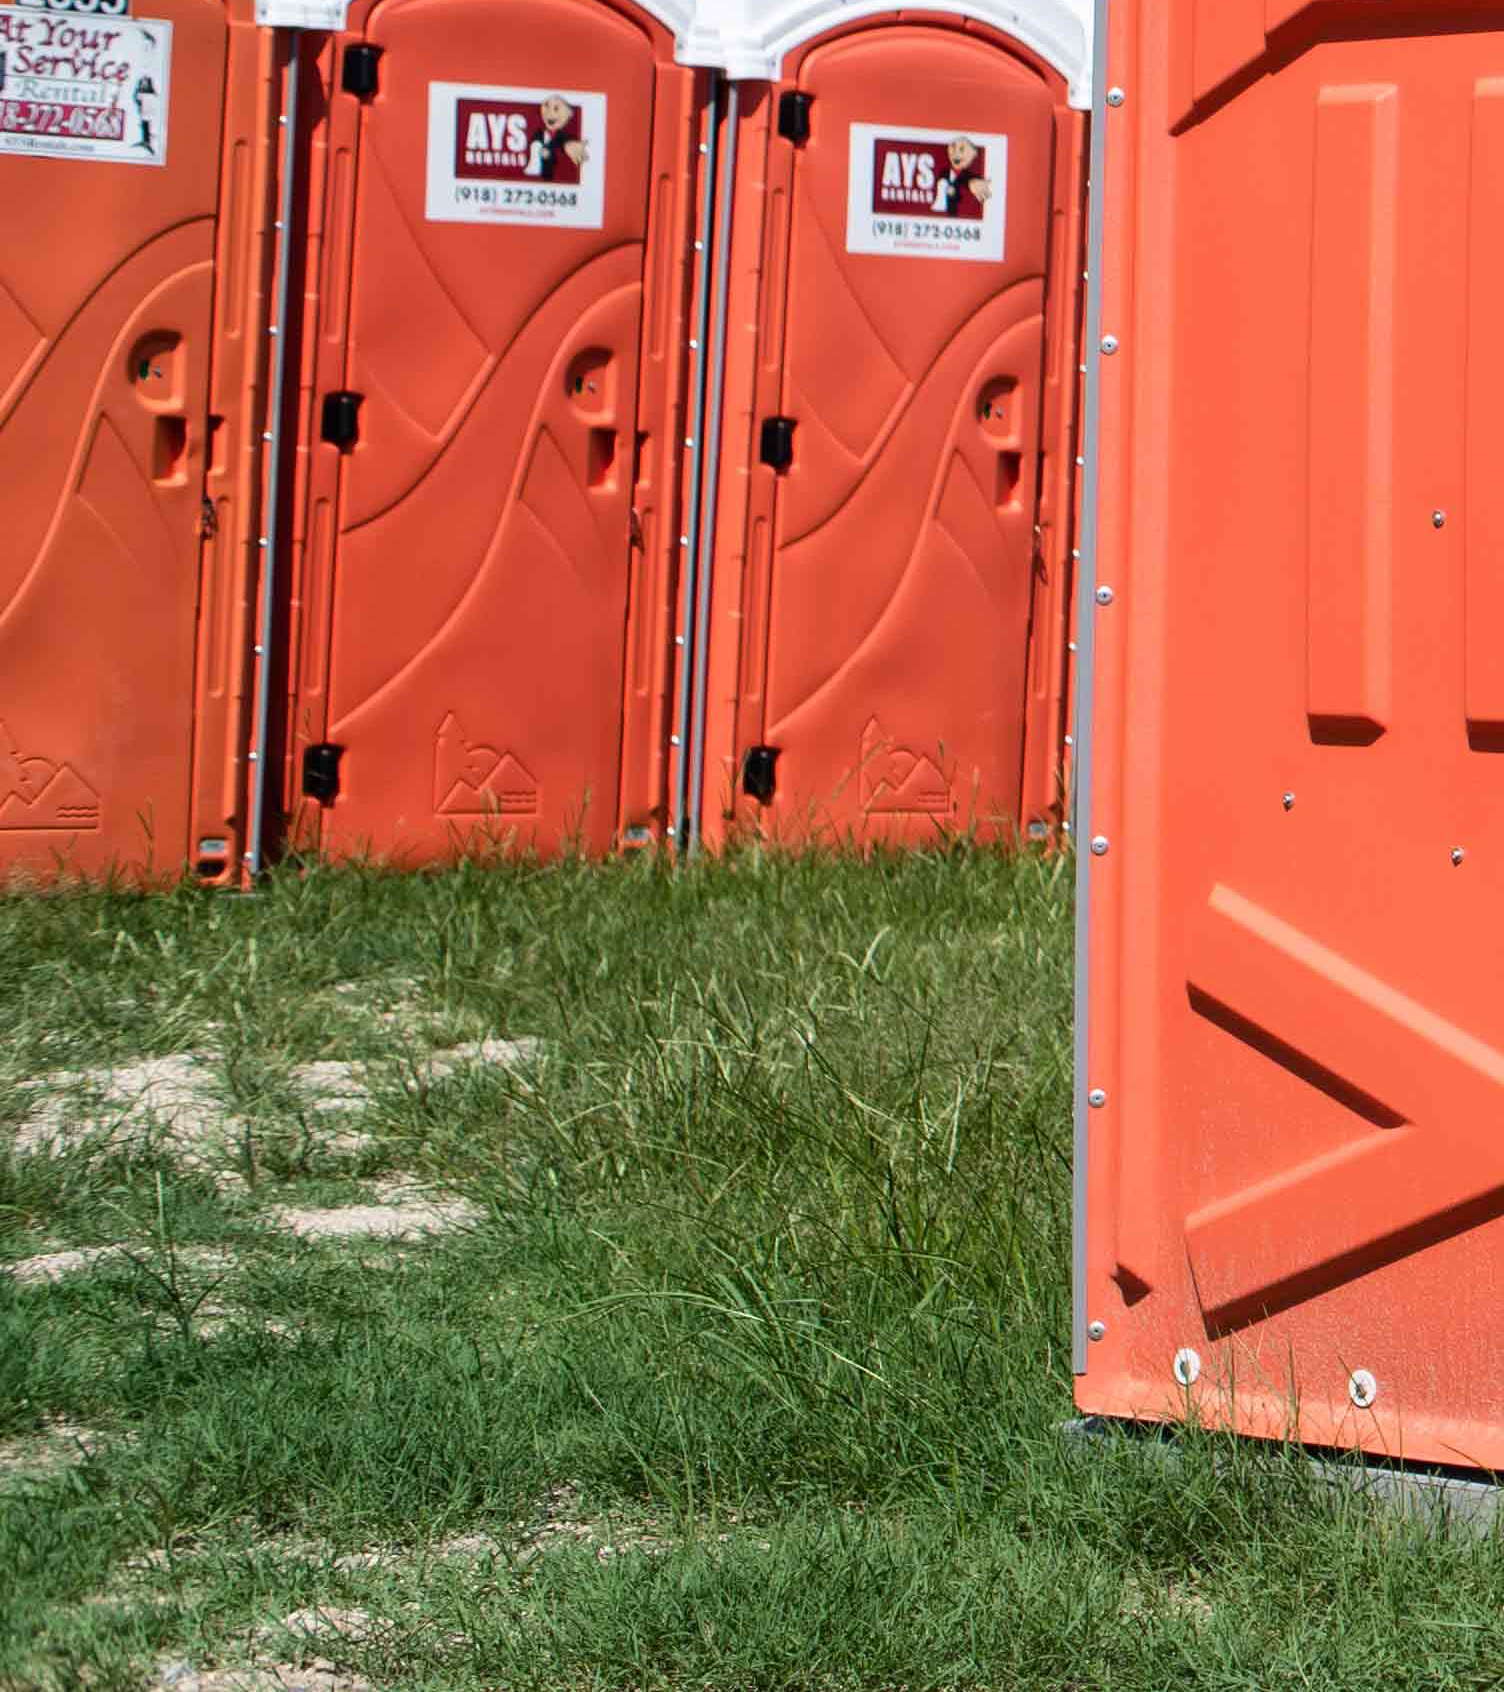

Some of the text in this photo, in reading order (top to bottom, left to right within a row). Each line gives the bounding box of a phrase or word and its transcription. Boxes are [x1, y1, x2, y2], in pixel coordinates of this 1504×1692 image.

[38, 18, 121, 51] Your
[13, 45, 130, 83] Service
[466, 112, 528, 152] AYS
[882, 151, 935, 190] AYS
[455, 186, 577, 206] (918) 272-0568
